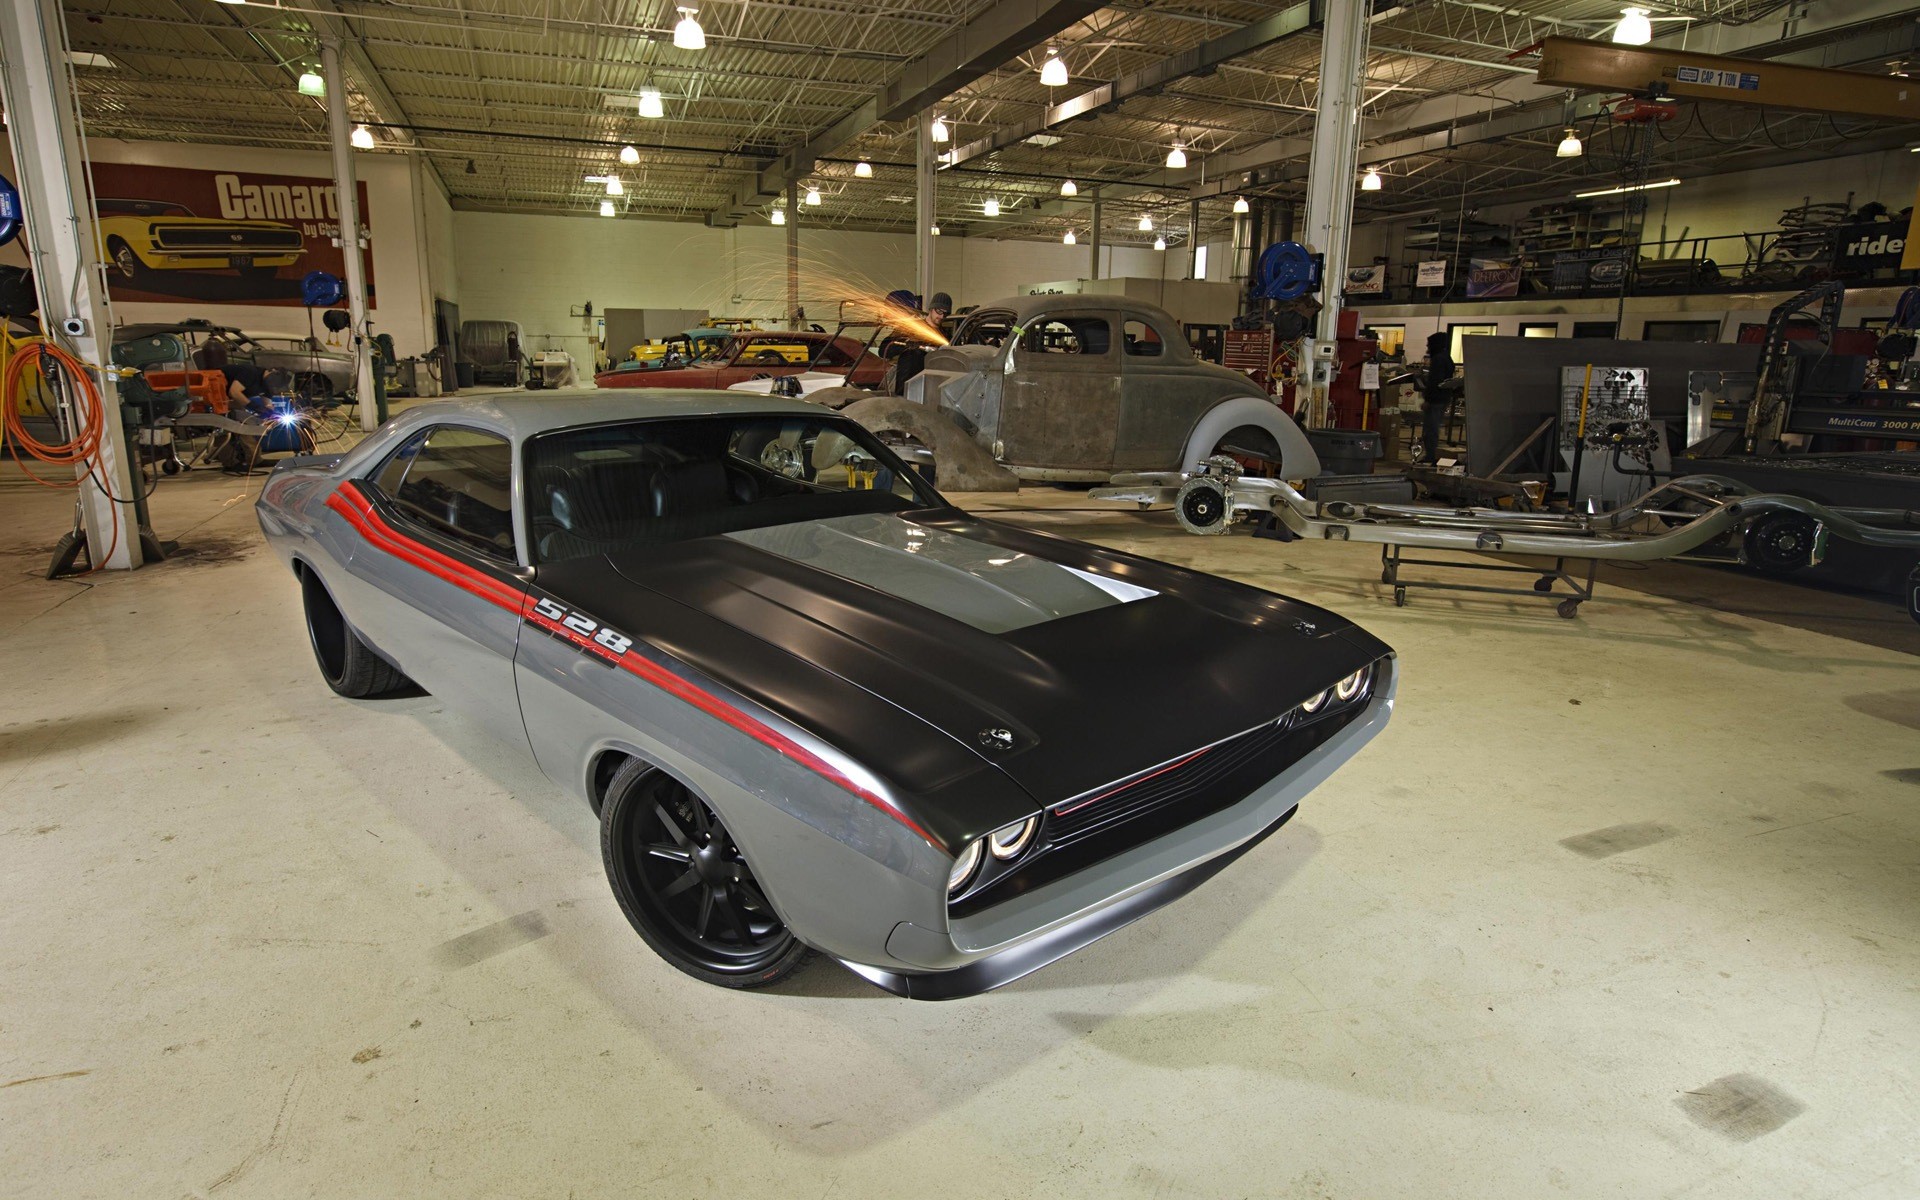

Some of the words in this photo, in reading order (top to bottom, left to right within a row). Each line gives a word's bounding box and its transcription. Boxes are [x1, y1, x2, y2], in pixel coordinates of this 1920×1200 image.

[1701, 70, 1714, 83] CAP
[1718, 71, 1724, 86] 1
[1724, 73, 1737, 86] TON
[303, 222, 317, 238] by
[1846, 234, 1906, 256] ride
[1828, 418, 1877, 428] MultiCam
[1882, 420, 1908, 429] 3000
[534, 597, 633, 654] 528
